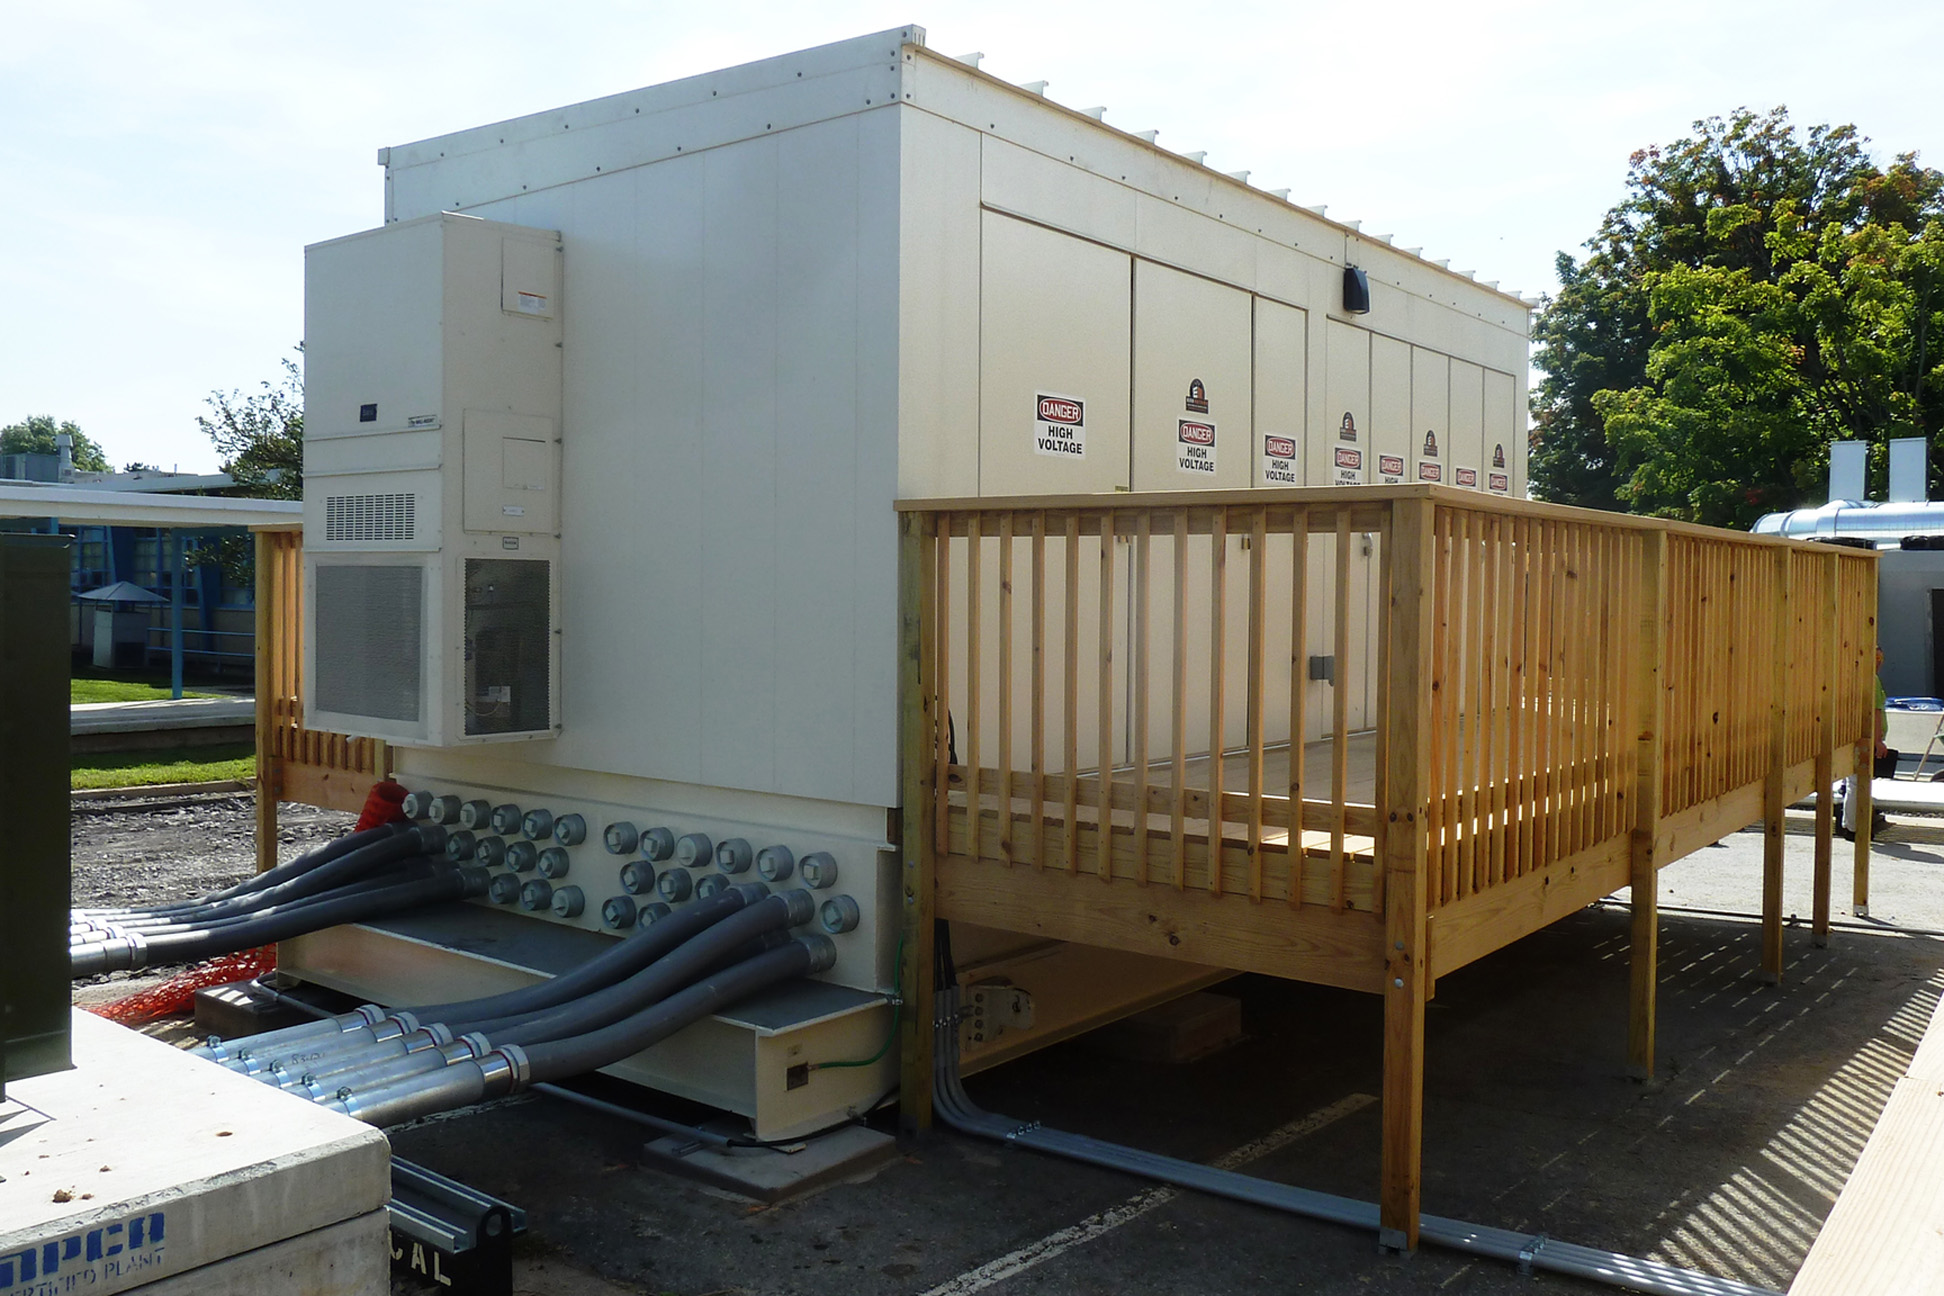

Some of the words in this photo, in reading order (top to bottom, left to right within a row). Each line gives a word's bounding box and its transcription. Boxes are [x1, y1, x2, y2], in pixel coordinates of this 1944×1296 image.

[1042, 402, 1079, 419] DANGER
[1048, 425, 1073, 439] HIGH
[1182, 425, 1212, 441] DANGER
[1038, 438, 1082, 454] VOLTAGE
[1186, 447, 1207, 459] HIGH
[1268, 441, 1293, 455] DANGER
[1179, 457, 1214, 472] VOLTAGE
[1272, 459, 1289, 471] HIGH
[1265, 470, 1295, 483] VOLTAGE
[105, 1247, 165, 1280] PLANT
